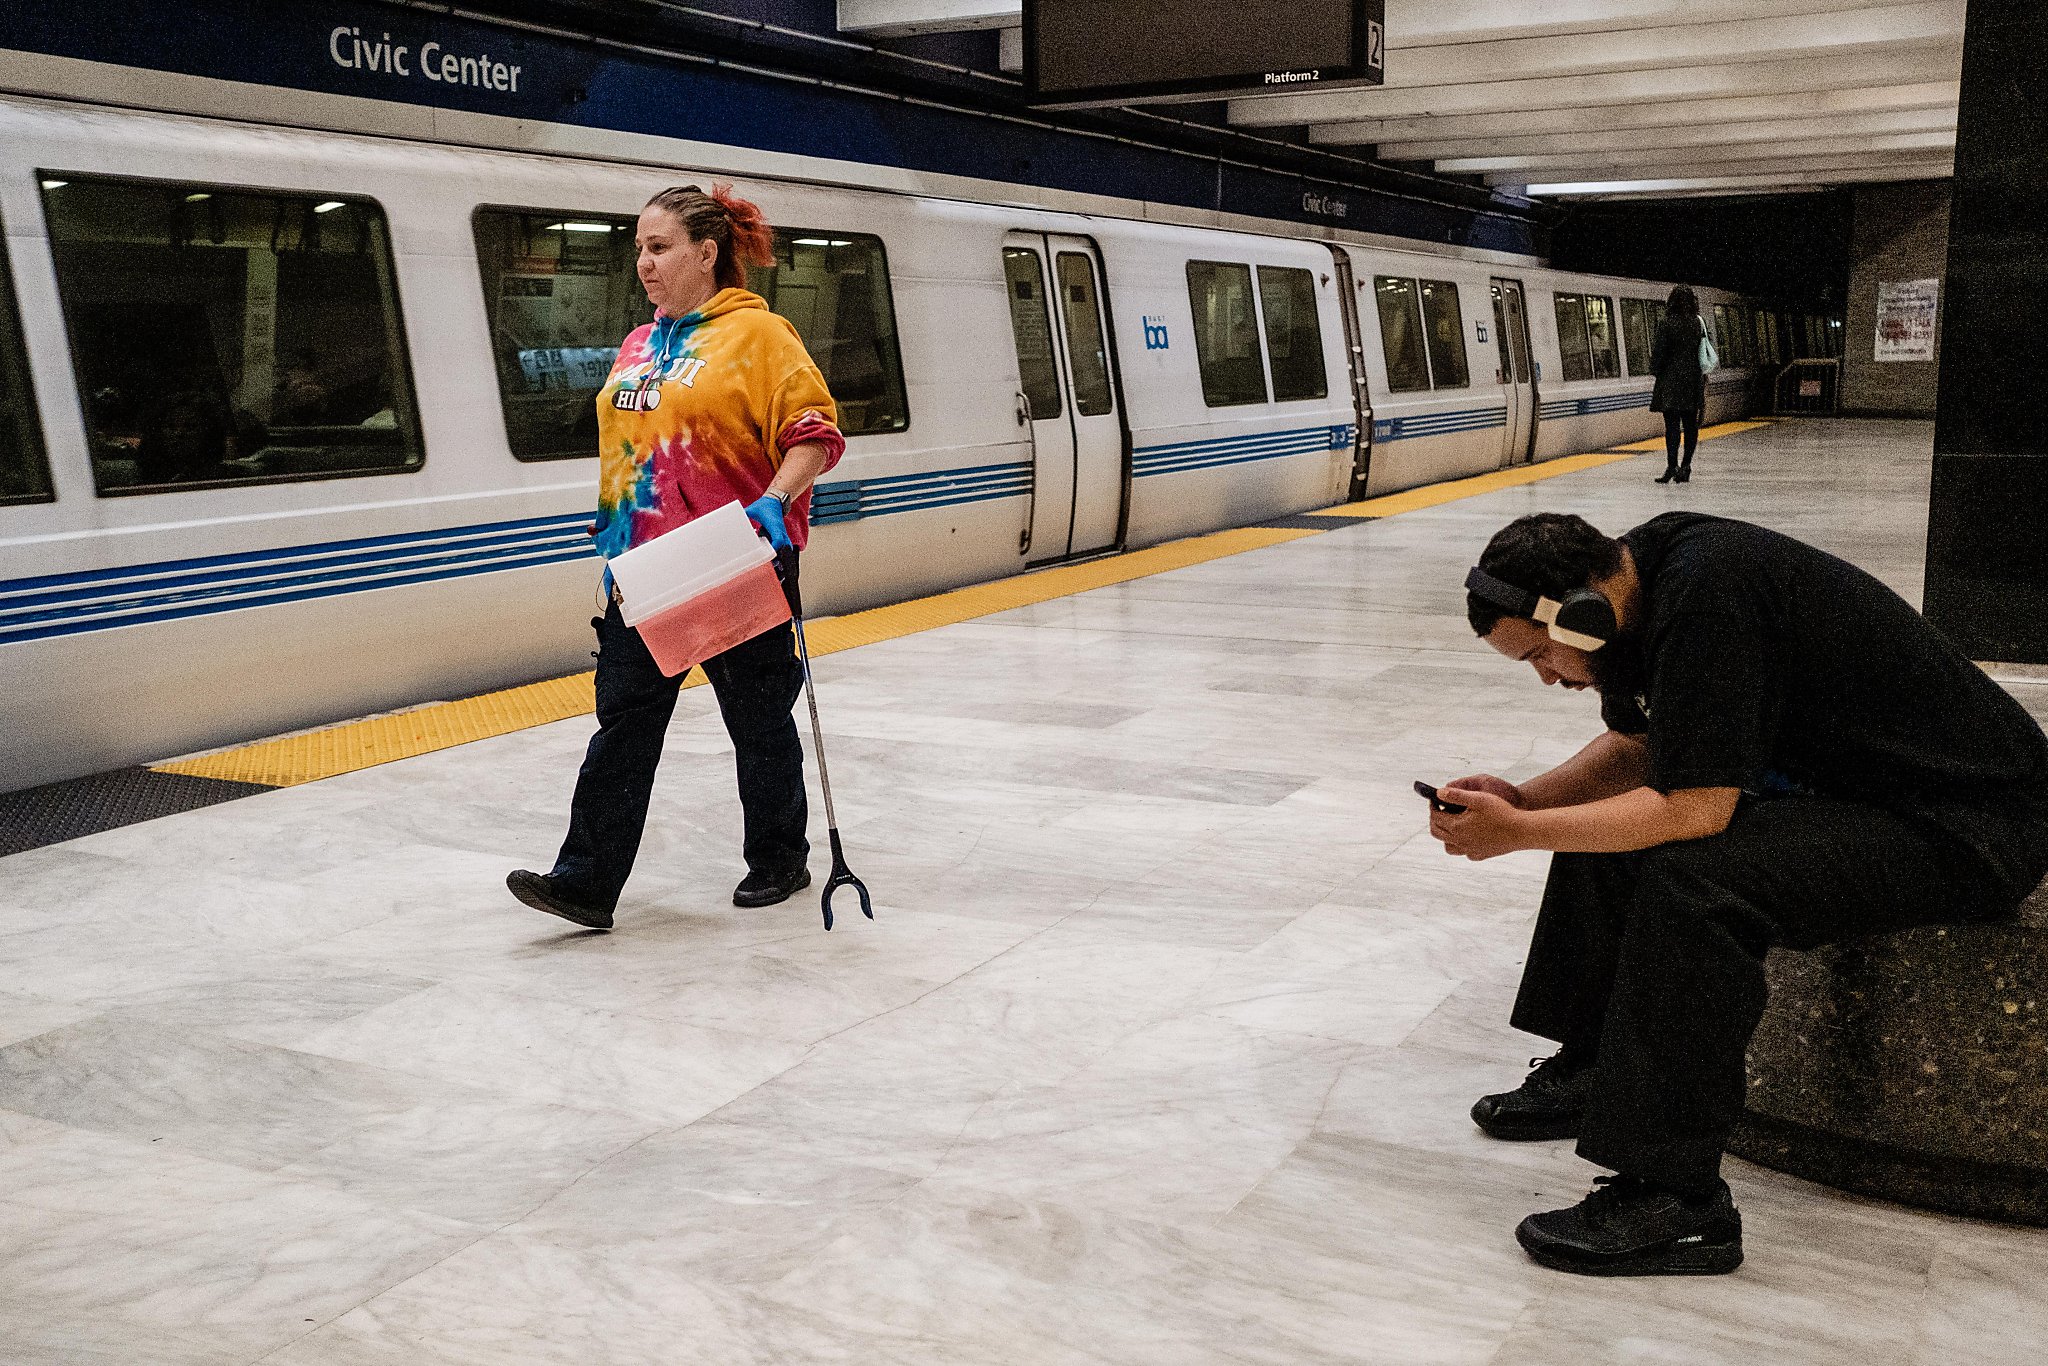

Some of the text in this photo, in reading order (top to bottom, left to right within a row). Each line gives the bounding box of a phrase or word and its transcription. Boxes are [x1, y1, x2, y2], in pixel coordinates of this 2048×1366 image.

[330, 26, 521, 92] Civic Center
[1371, 25, 1380, 65] 2
[1265, 70, 1319, 84] Platform 2
